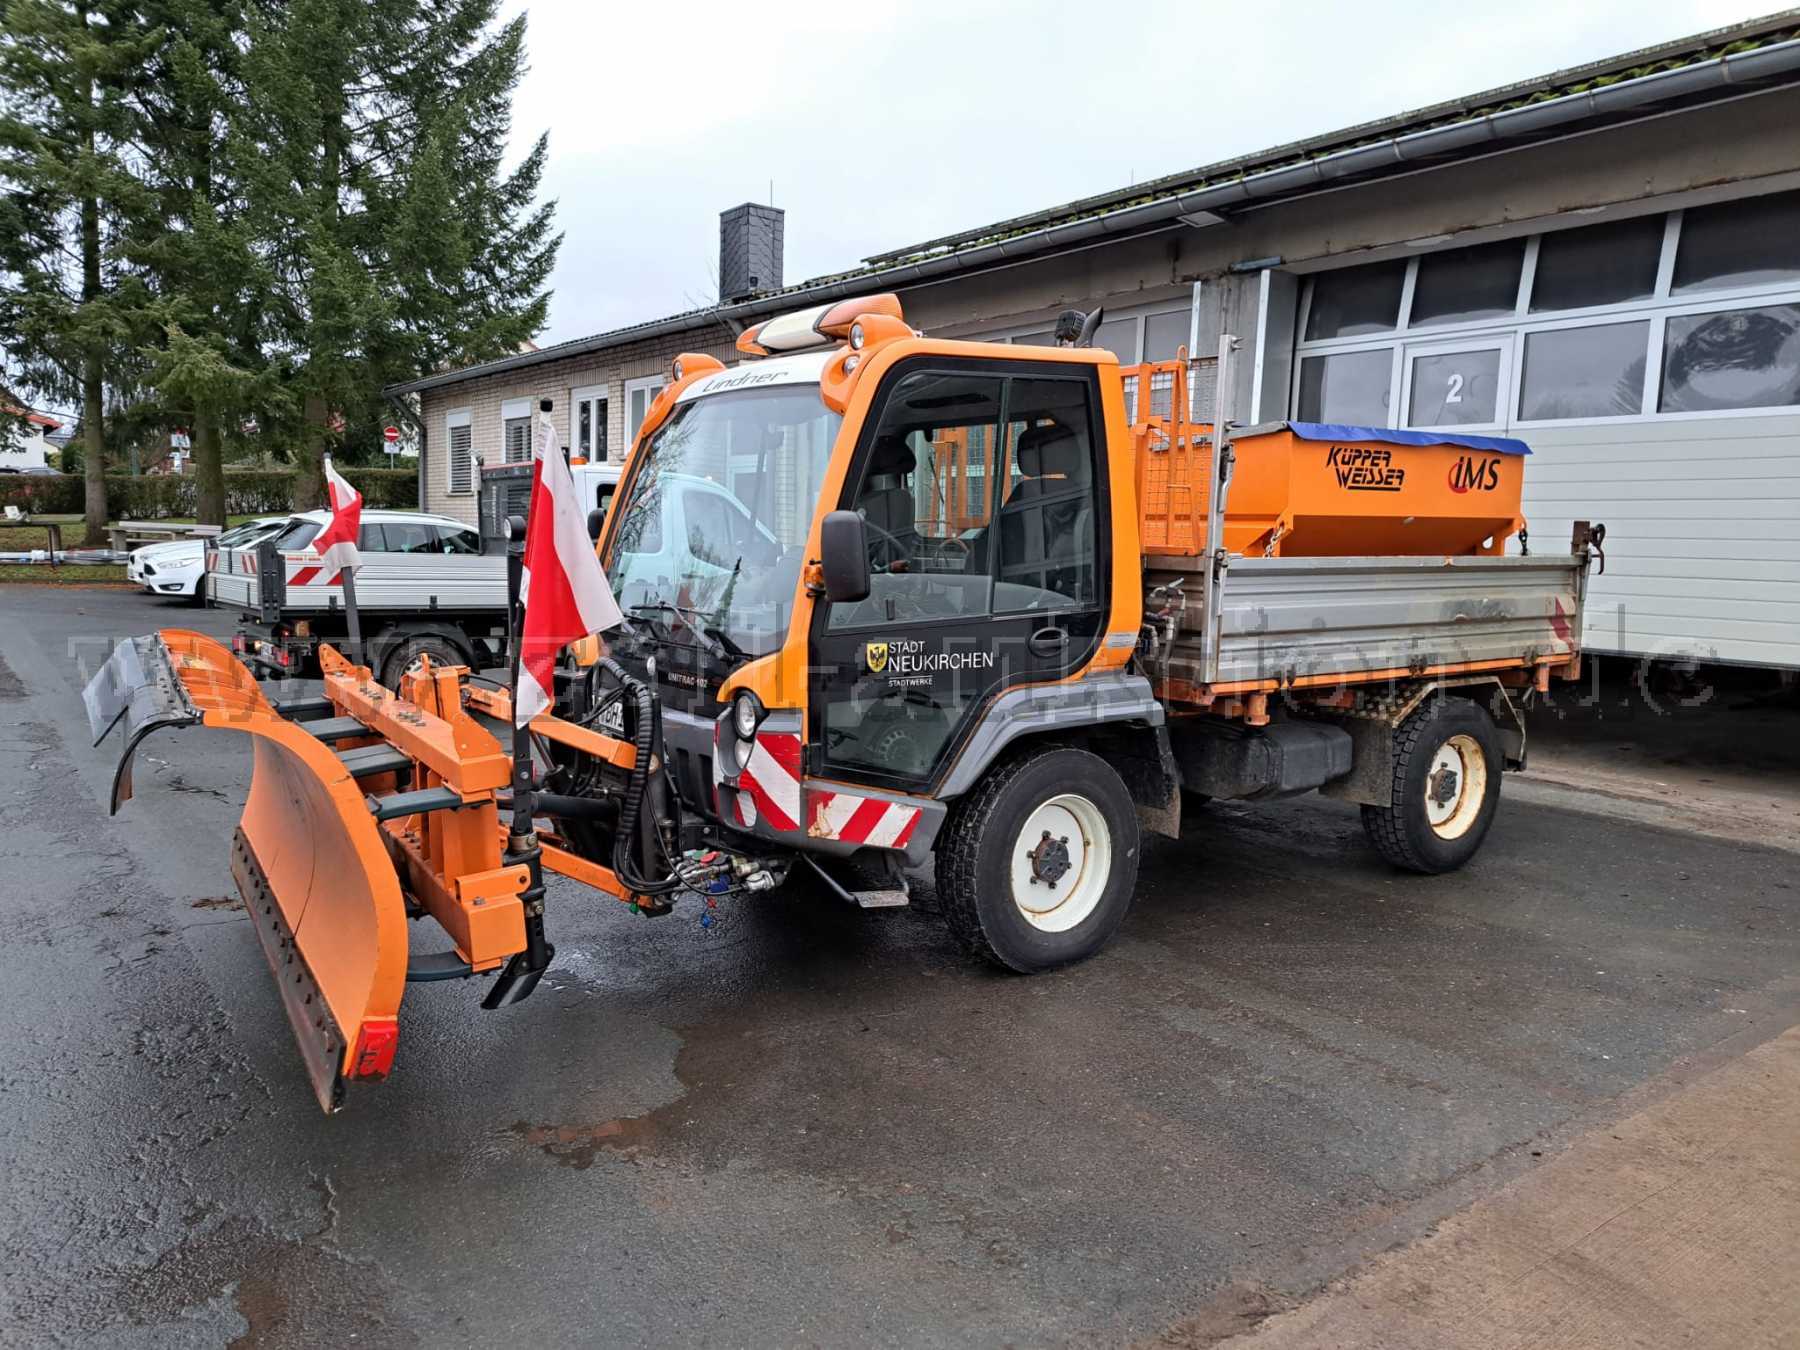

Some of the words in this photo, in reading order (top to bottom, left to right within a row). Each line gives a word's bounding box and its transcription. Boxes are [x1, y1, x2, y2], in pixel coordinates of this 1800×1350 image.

[702, 371, 789, 393] Lindner
[1446, 374, 1464, 404] 2
[888, 640, 926, 655] STADT
[888, 651, 994, 673] NEUKIRCHEN
[888, 677, 933, 688] STADTWERKE
